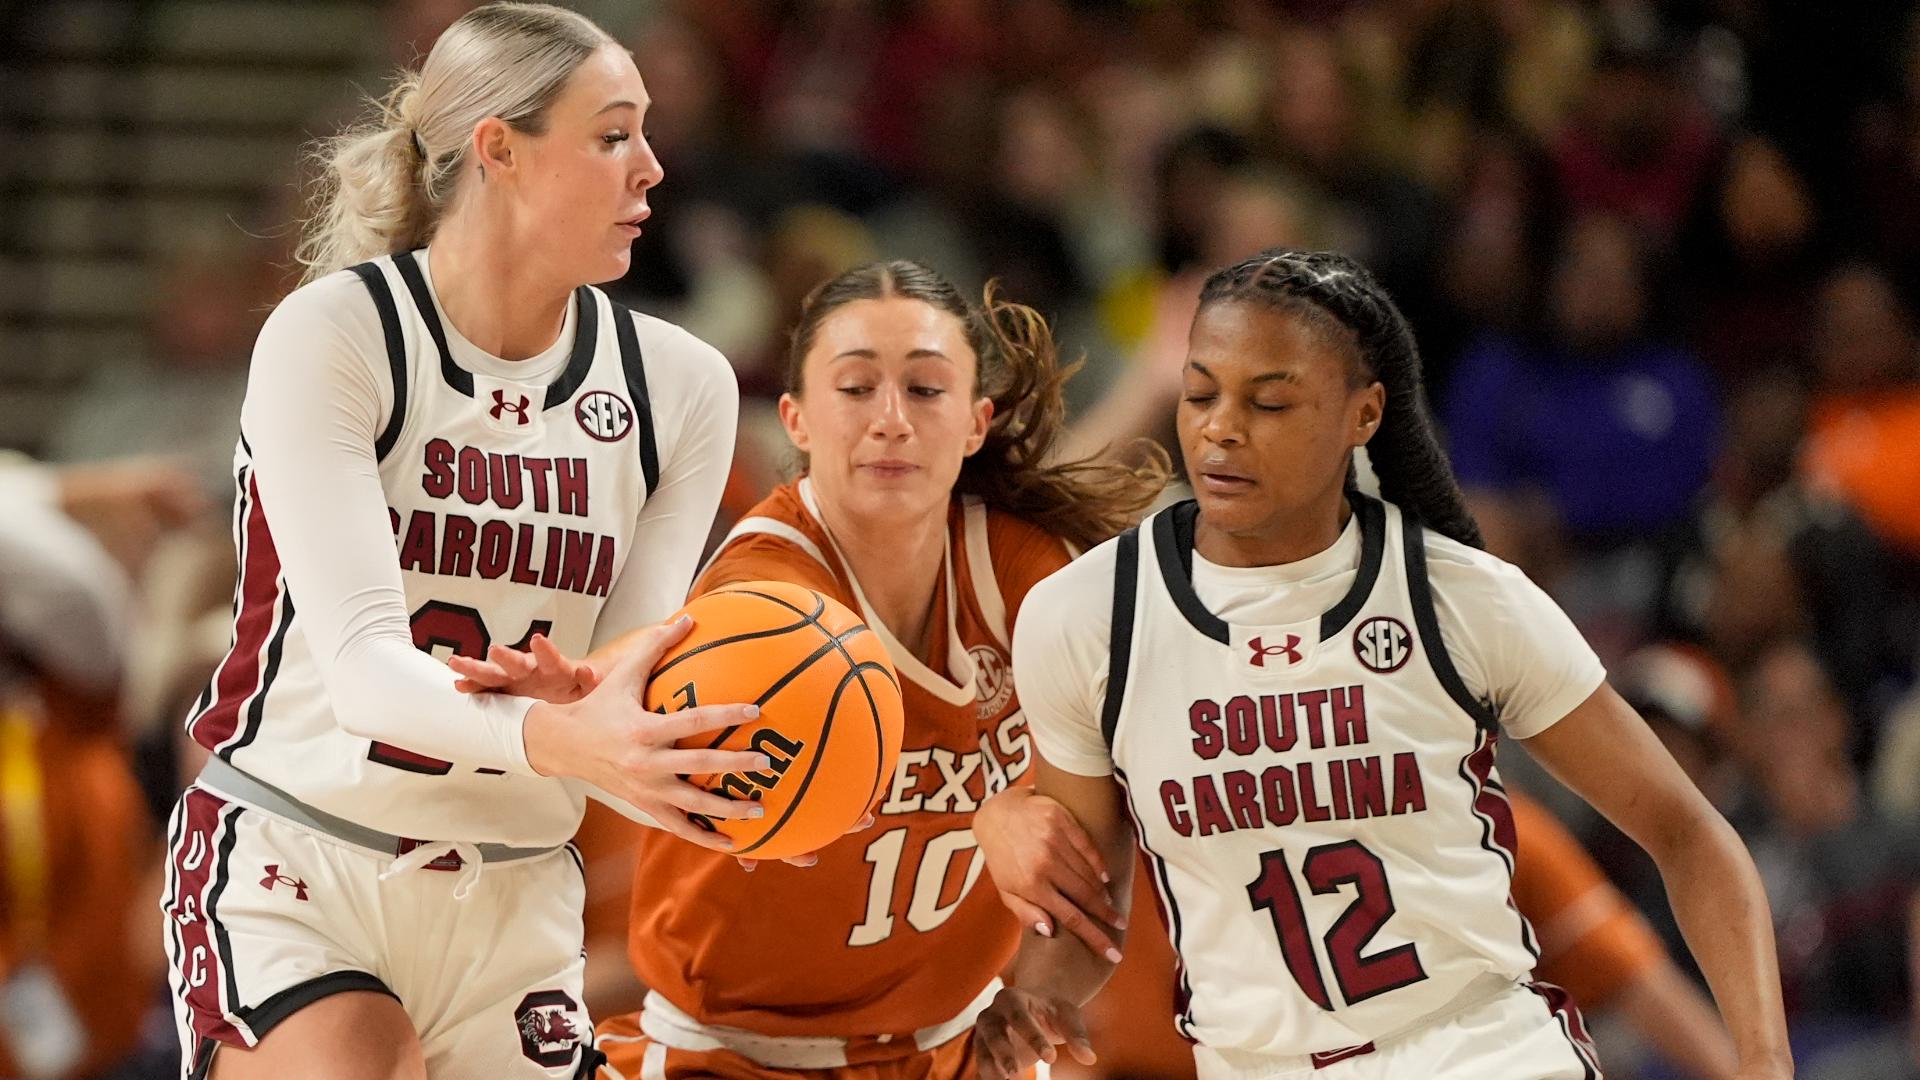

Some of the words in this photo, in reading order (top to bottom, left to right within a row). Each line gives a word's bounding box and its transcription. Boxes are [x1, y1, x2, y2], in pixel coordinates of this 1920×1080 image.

[580, 393, 630, 438] SEC
[422, 437, 589, 517] SOUTH
[1357, 620, 1409, 669] SEC
[881, 708, 1033, 815] EXAS
[1189, 684, 1369, 760] SOUTH
[1159, 751, 1427, 837] CAROLINA
[847, 826, 986, 947] 10
[1245, 838, 1430, 1012] 12
